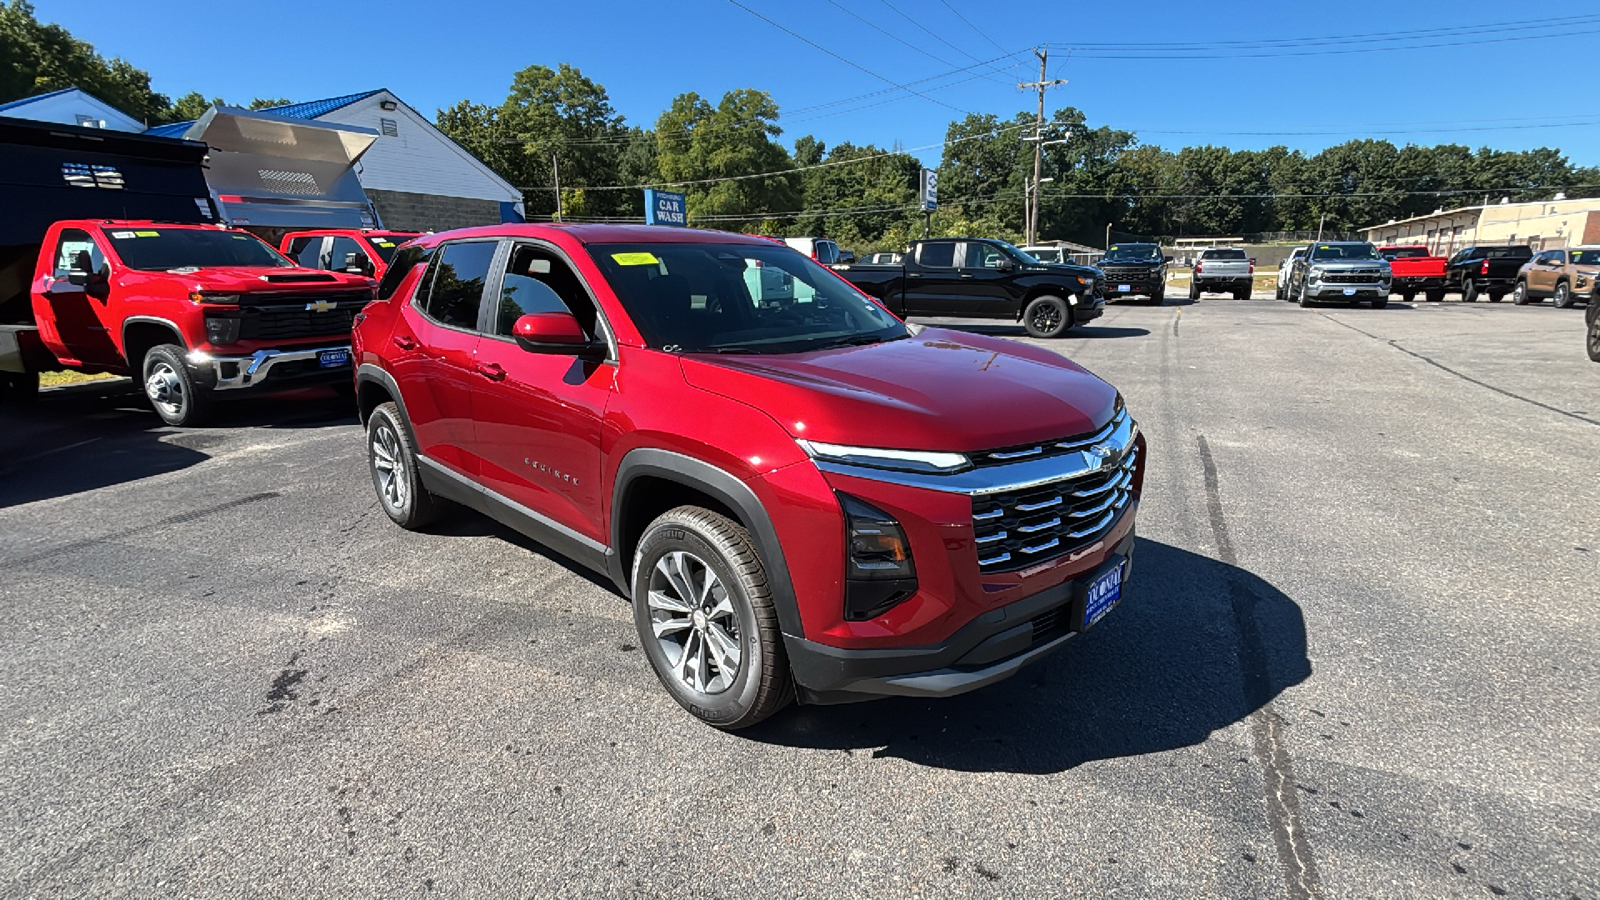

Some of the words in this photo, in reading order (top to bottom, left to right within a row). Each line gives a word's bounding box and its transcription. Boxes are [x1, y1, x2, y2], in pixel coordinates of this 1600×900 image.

[659, 199, 679, 212] CAR
[657, 210, 684, 224] WASH
[320, 351, 348, 362] COLONIAL
[524, 457, 579, 487] EQUINOX
